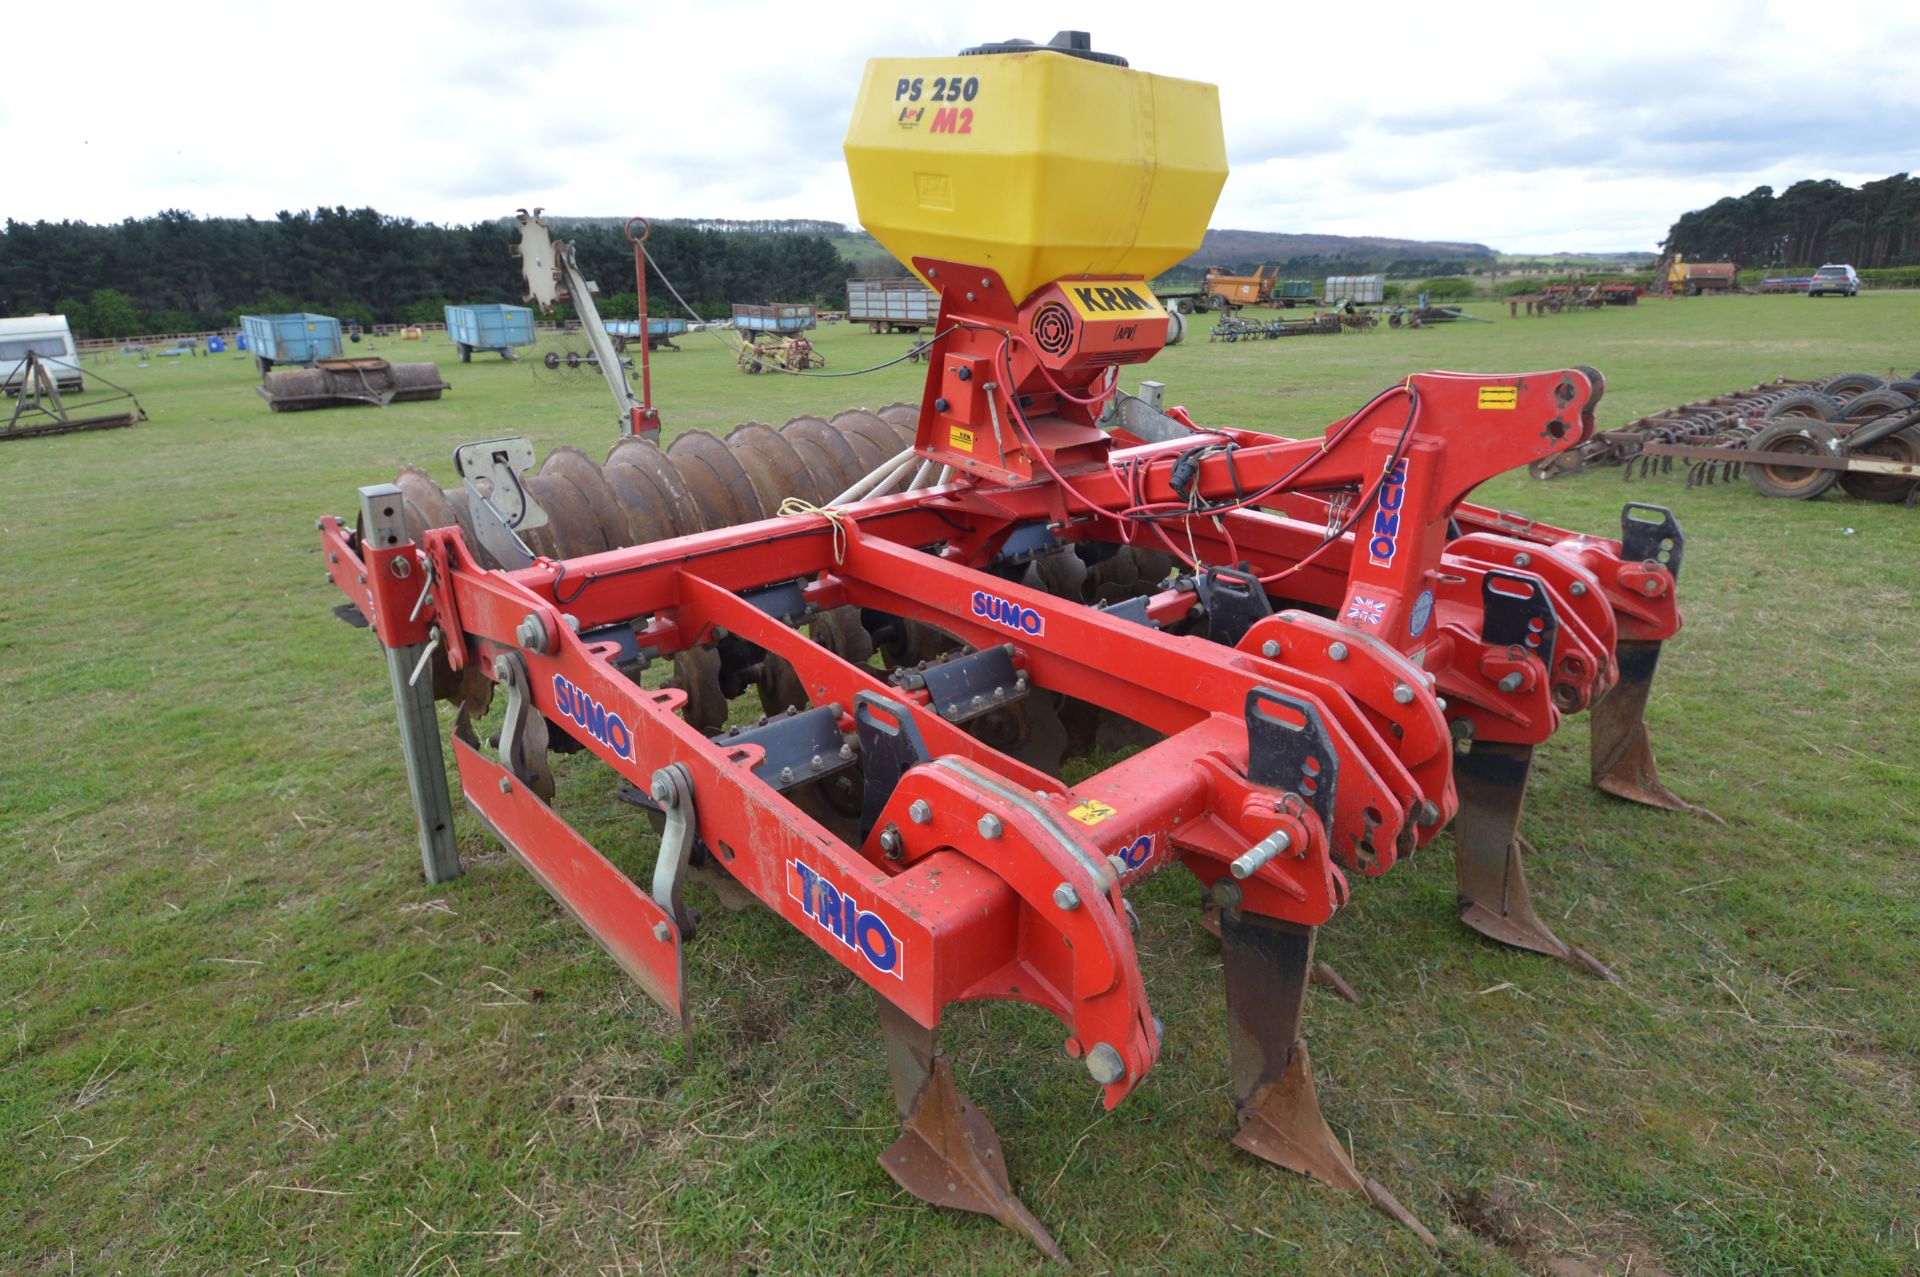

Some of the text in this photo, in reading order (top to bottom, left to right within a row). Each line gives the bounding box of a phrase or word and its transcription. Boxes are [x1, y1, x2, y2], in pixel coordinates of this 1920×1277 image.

[895, 77, 979, 102] PS 250
[929, 107, 974, 134] M2
[1073, 287, 1155, 312] KRM
[1370, 460, 1406, 559] SUMO
[974, 591, 1041, 634] SUMO
[555, 675, 631, 758] SUMO
[796, 860, 897, 971] TRIO
